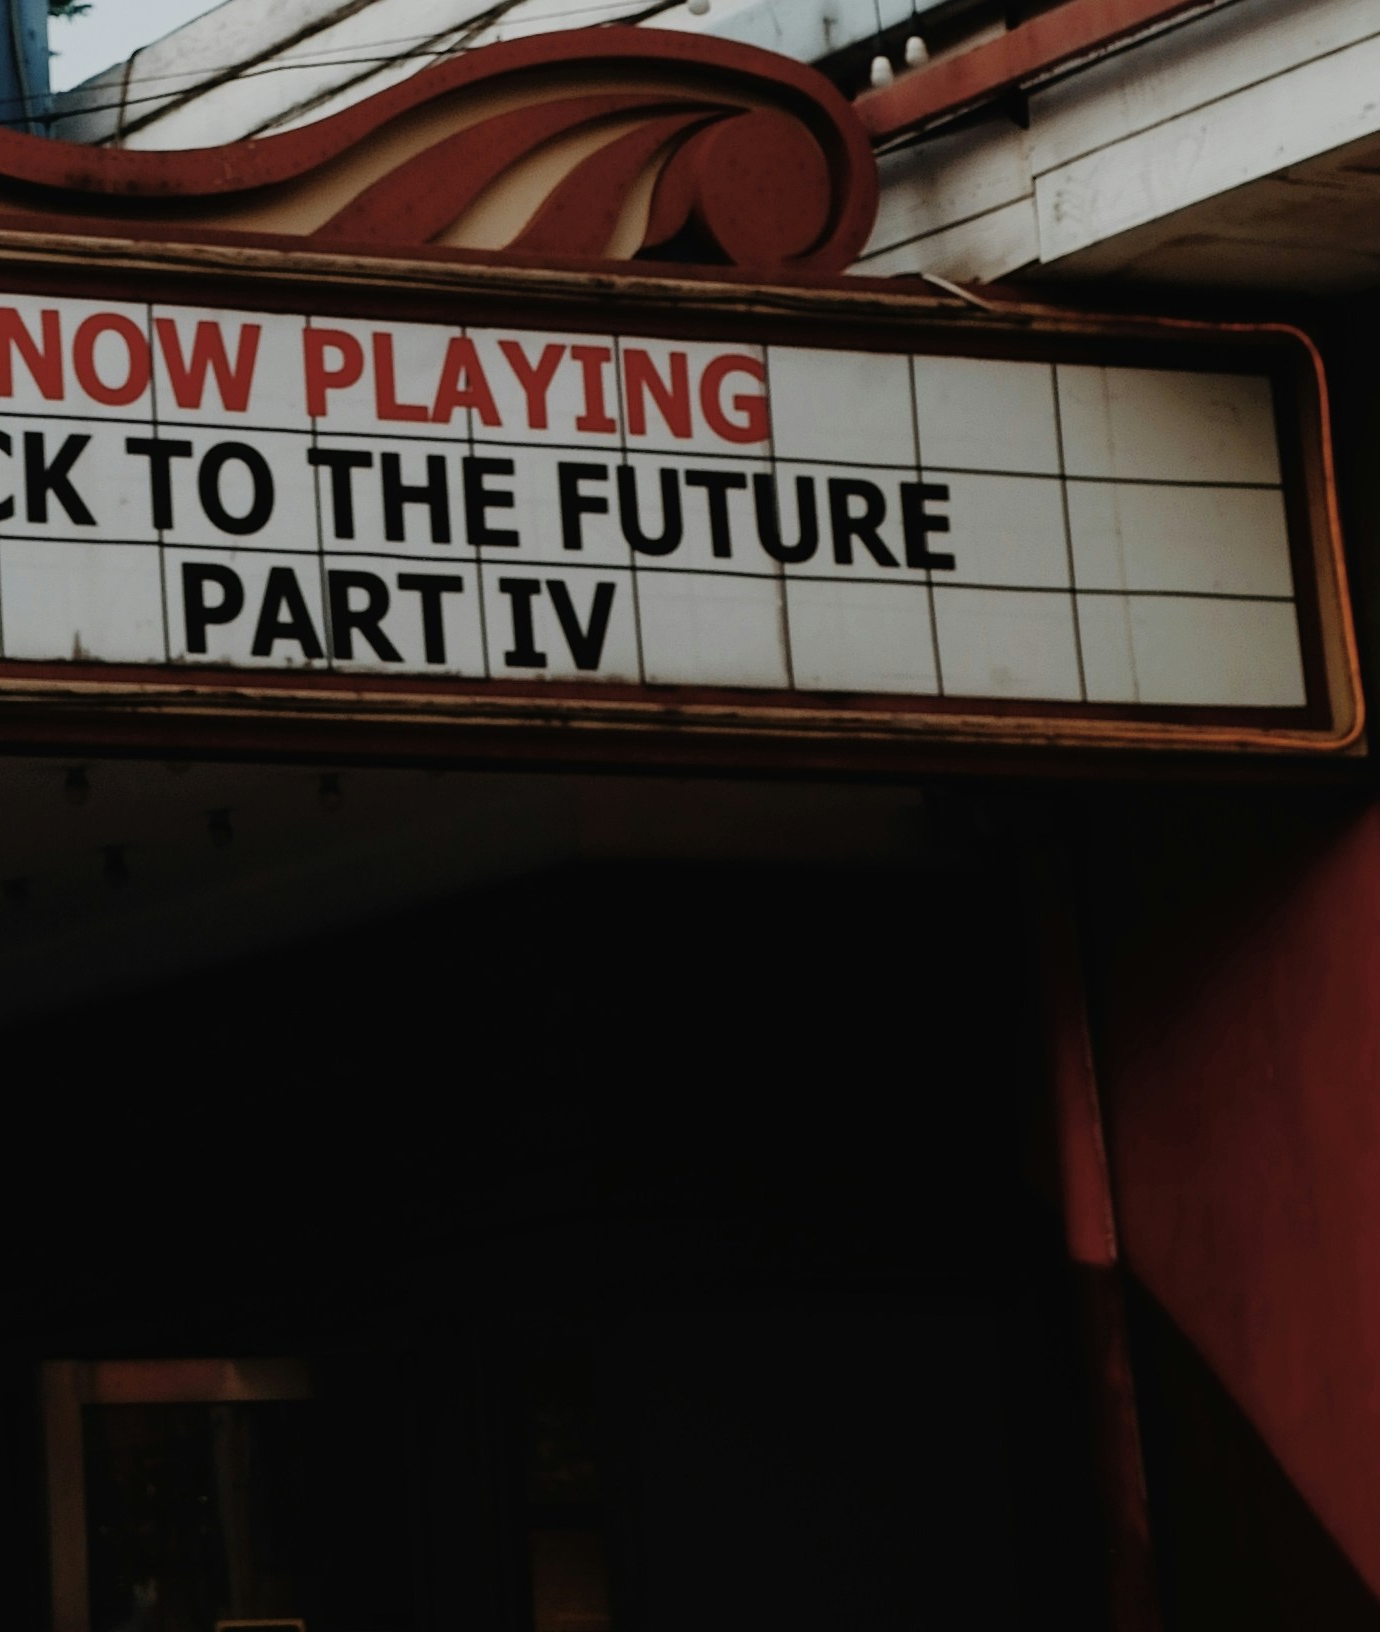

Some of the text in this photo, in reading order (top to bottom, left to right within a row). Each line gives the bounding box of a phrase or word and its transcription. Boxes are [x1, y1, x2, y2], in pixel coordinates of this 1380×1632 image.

[304, 328, 770, 444] PLAYING
[126, 435, 276, 537] TO
[307, 445, 522, 549] THE
[556, 461, 958, 573] FUTURE
[181, 560, 618, 673] PART IV
